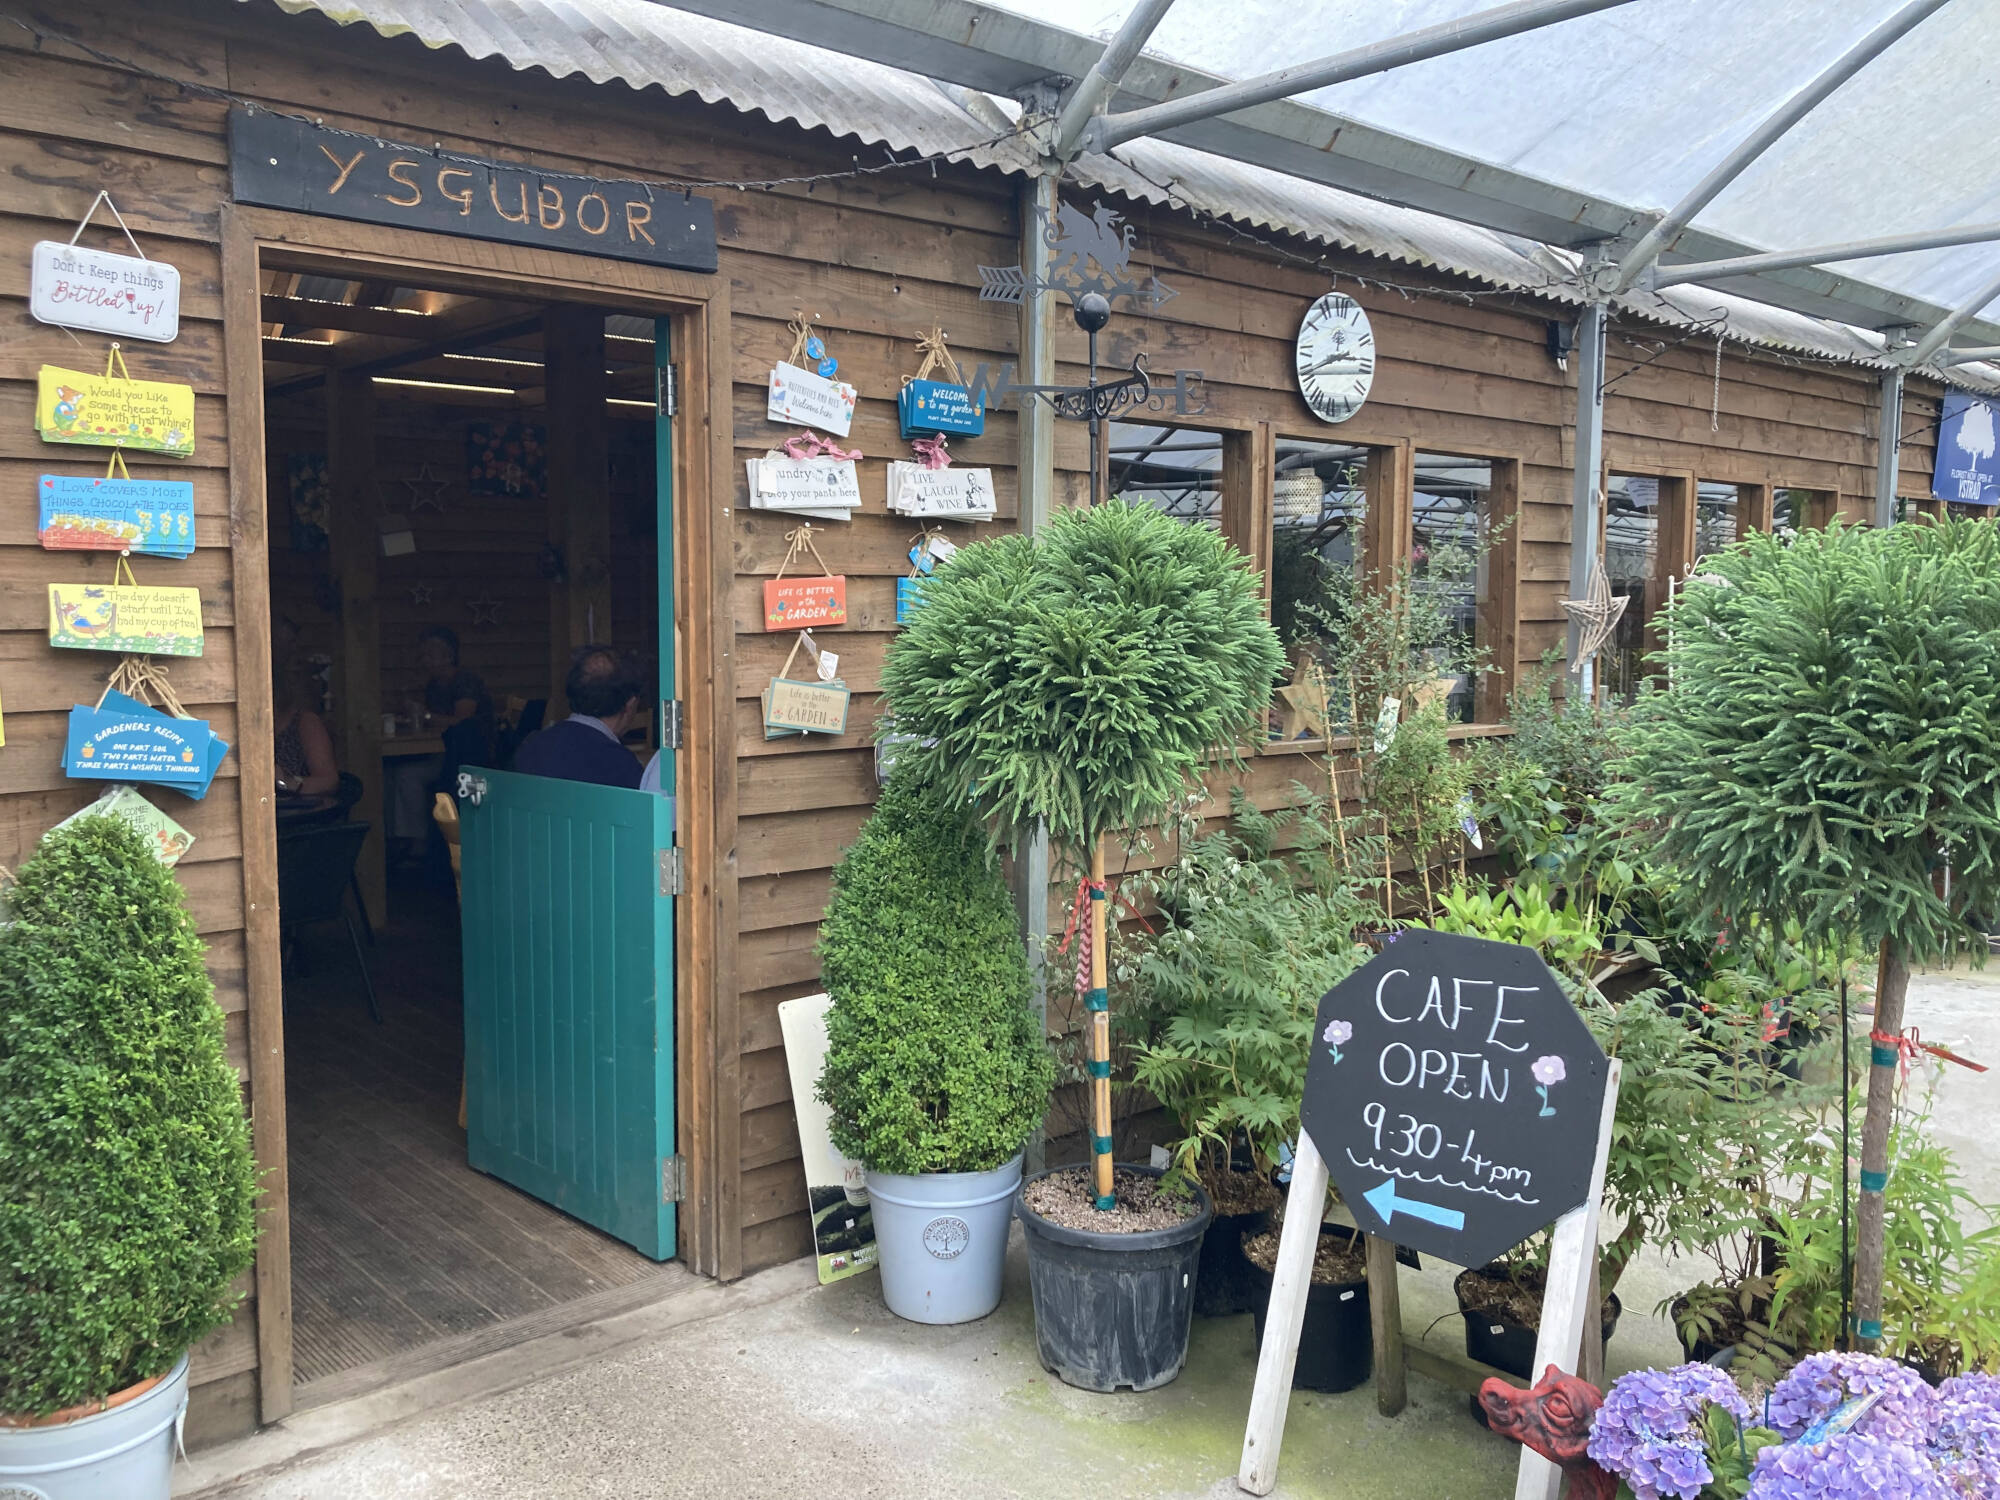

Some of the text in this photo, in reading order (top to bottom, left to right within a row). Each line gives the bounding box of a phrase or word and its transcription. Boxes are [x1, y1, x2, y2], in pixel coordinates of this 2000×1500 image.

[52, 257, 164, 291] Don't Keep things
[51, 280, 165, 324] Bottled up!
[90, 385, 121, 398] Would
[125, 392, 143, 404] you
[89, 401, 172, 415] some cheese to
[928, 398, 973, 417] to my garden
[86, 412, 191, 430] go with that whine?
[776, 468, 812, 482] undry
[912, 472, 935, 484] LIVE
[100, 484, 148, 497] COVERS
[152, 487, 185, 498] MOST
[790, 490, 810, 501] your
[813, 488, 836, 499] pants
[840, 488, 857, 497] here
[924, 485, 958, 497] LAUGH
[90, 497, 154, 510] CHOCOLATE
[159, 501, 189, 511] DOES
[936, 499, 962, 509] WINE
[106, 590, 128, 602] The
[130, 592, 150, 606] day
[778, 586, 834, 597] LIFE IS BETTER
[120, 604, 149, 614] start
[150, 604, 172, 615] until
[786, 607, 828, 620] GARDEN
[117, 615, 134, 626] had
[136, 619, 150, 630] my
[151, 619, 168, 630] cup
[169, 617, 179, 628] of
[811, 690, 831, 703] better
[788, 707, 827, 725] GARDEN
[94, 722, 185, 745] GARDENERS RECIPE
[112, 743, 127, 751] ONE
[129, 744, 151, 752] PART
[102, 752, 177, 762] TWO PARTS WATER
[75, 761, 200, 774] THREE PARTS WISHFUL THINKING
[1375, 969, 1540, 1052] CAFE
[1379, 1042, 1509, 1103] OPEN
